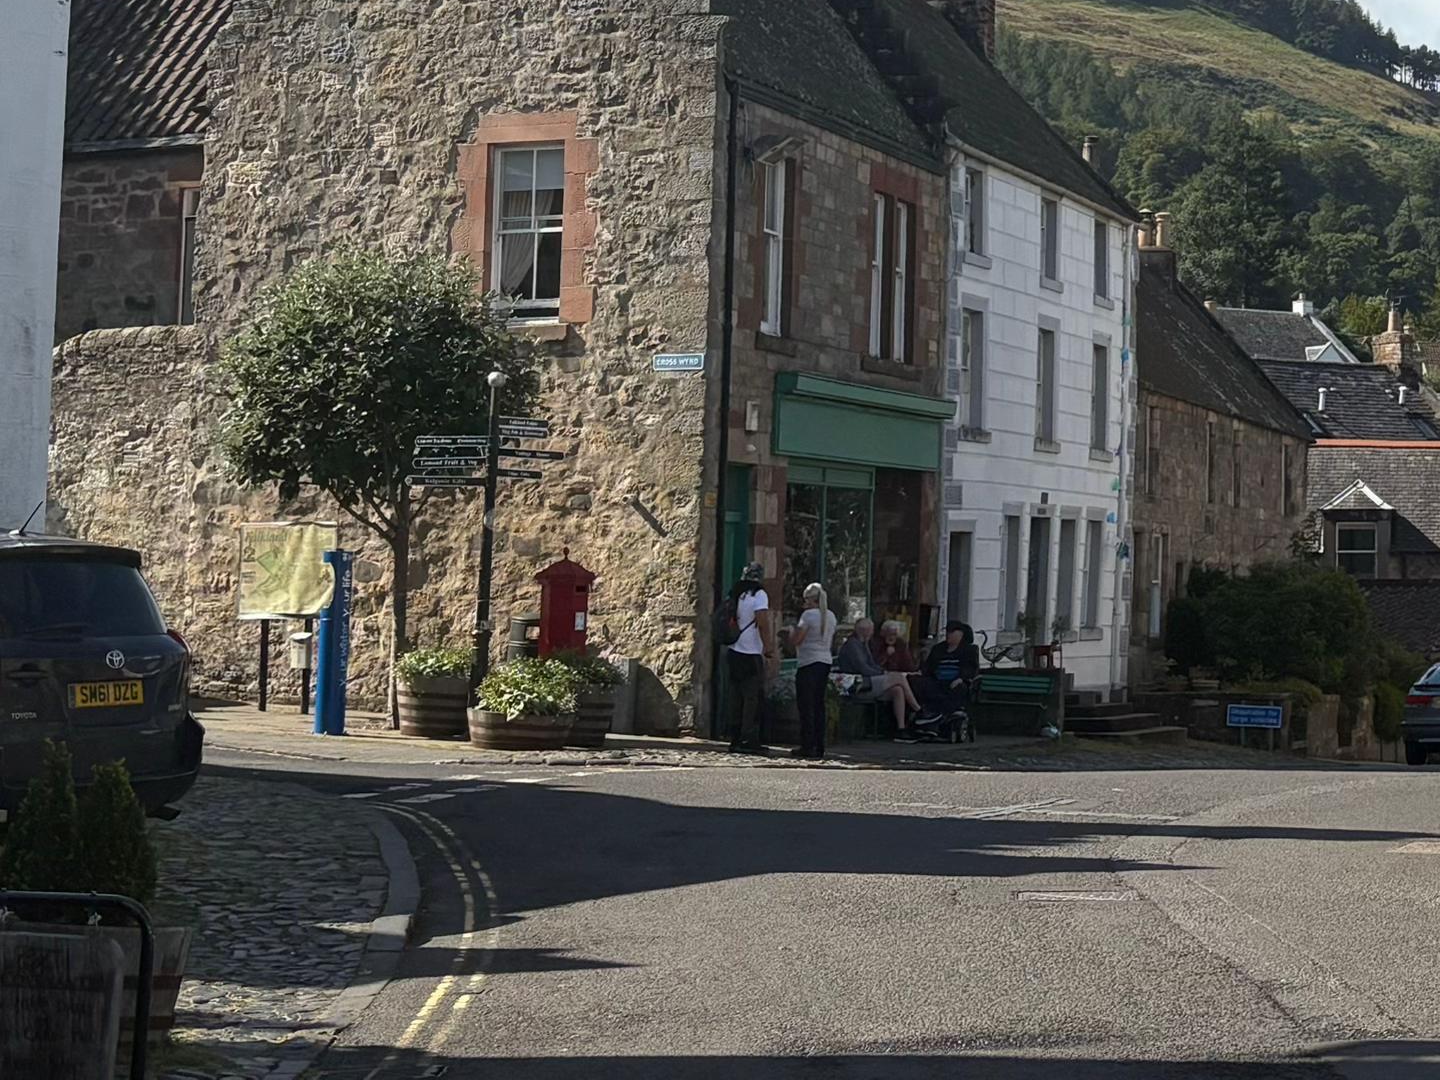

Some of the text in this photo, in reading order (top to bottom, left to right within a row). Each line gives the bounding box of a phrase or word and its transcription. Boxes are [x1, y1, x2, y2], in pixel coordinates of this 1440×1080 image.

[656, 357, 699, 366] CROSS WYND
[342, 569, 351, 588] life
[80, 682, 138, 704] SM61 DZG
[11, 712, 38, 720] TOYOTA
